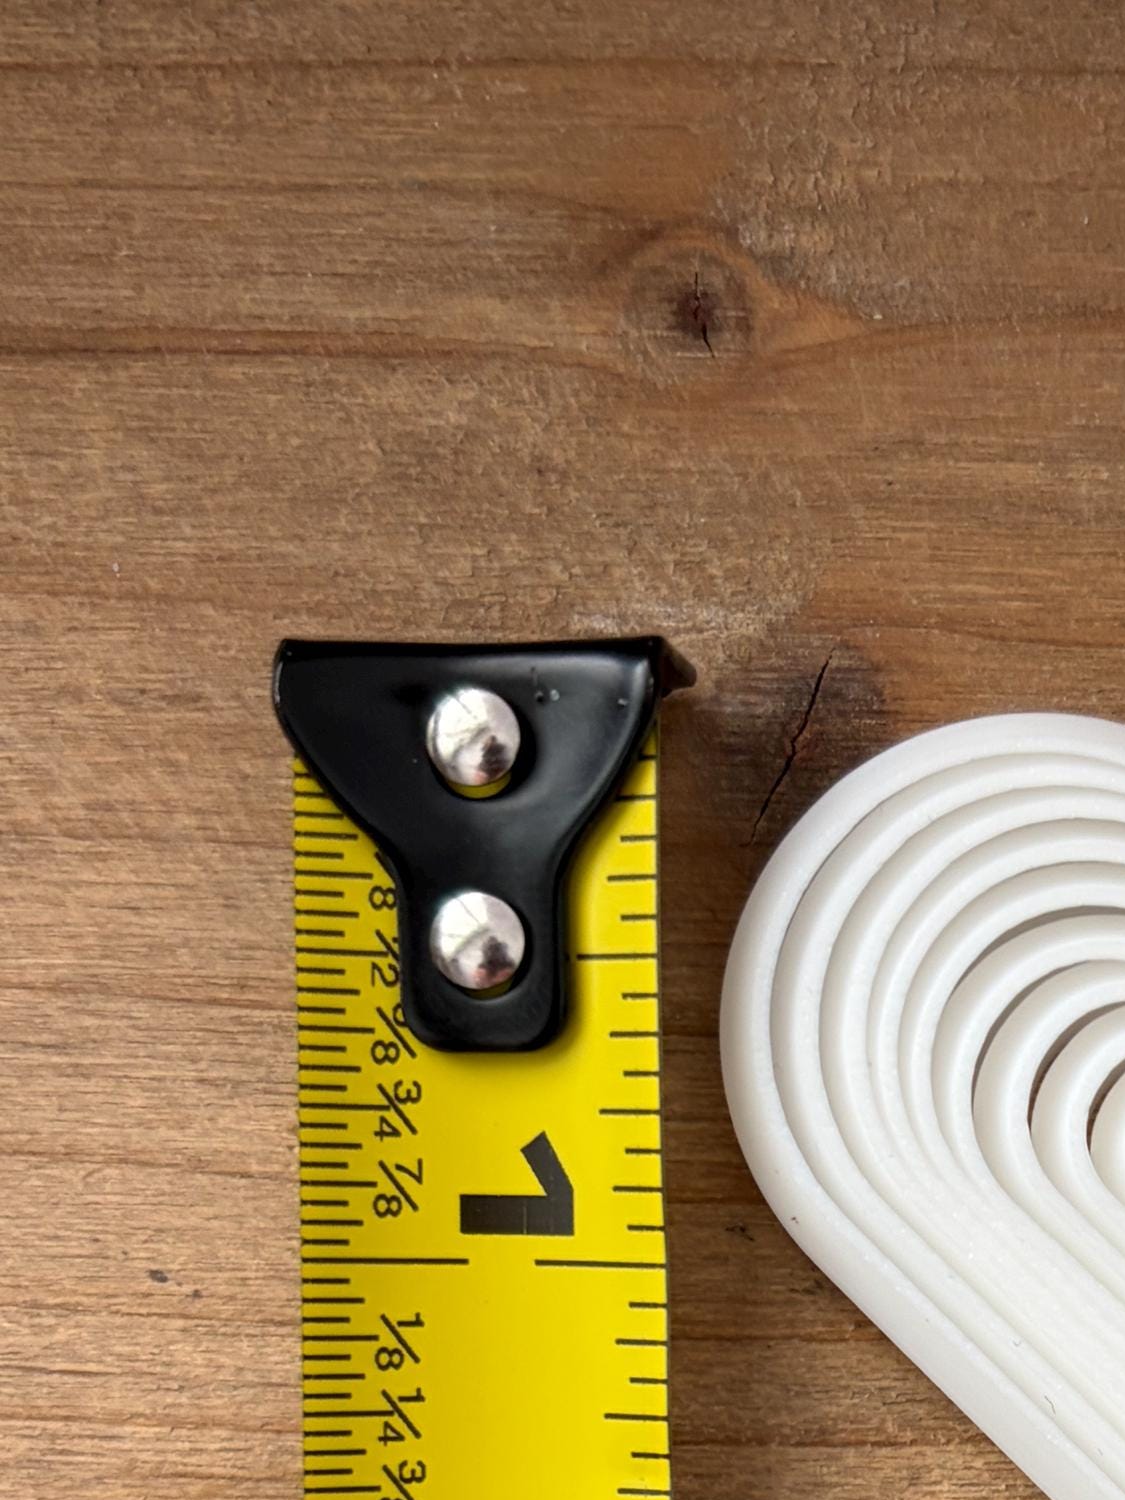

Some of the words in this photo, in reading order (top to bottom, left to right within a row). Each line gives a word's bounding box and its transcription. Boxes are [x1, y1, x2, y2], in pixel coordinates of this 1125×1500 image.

[373, 1080, 423, 1142] 3/4
[372, 1158, 424, 1219] 7/8
[460, 1131, 575, 1237] 1
[374, 1312, 425, 1371] 1/8
[377, 1387, 426, 1446] 1/4
